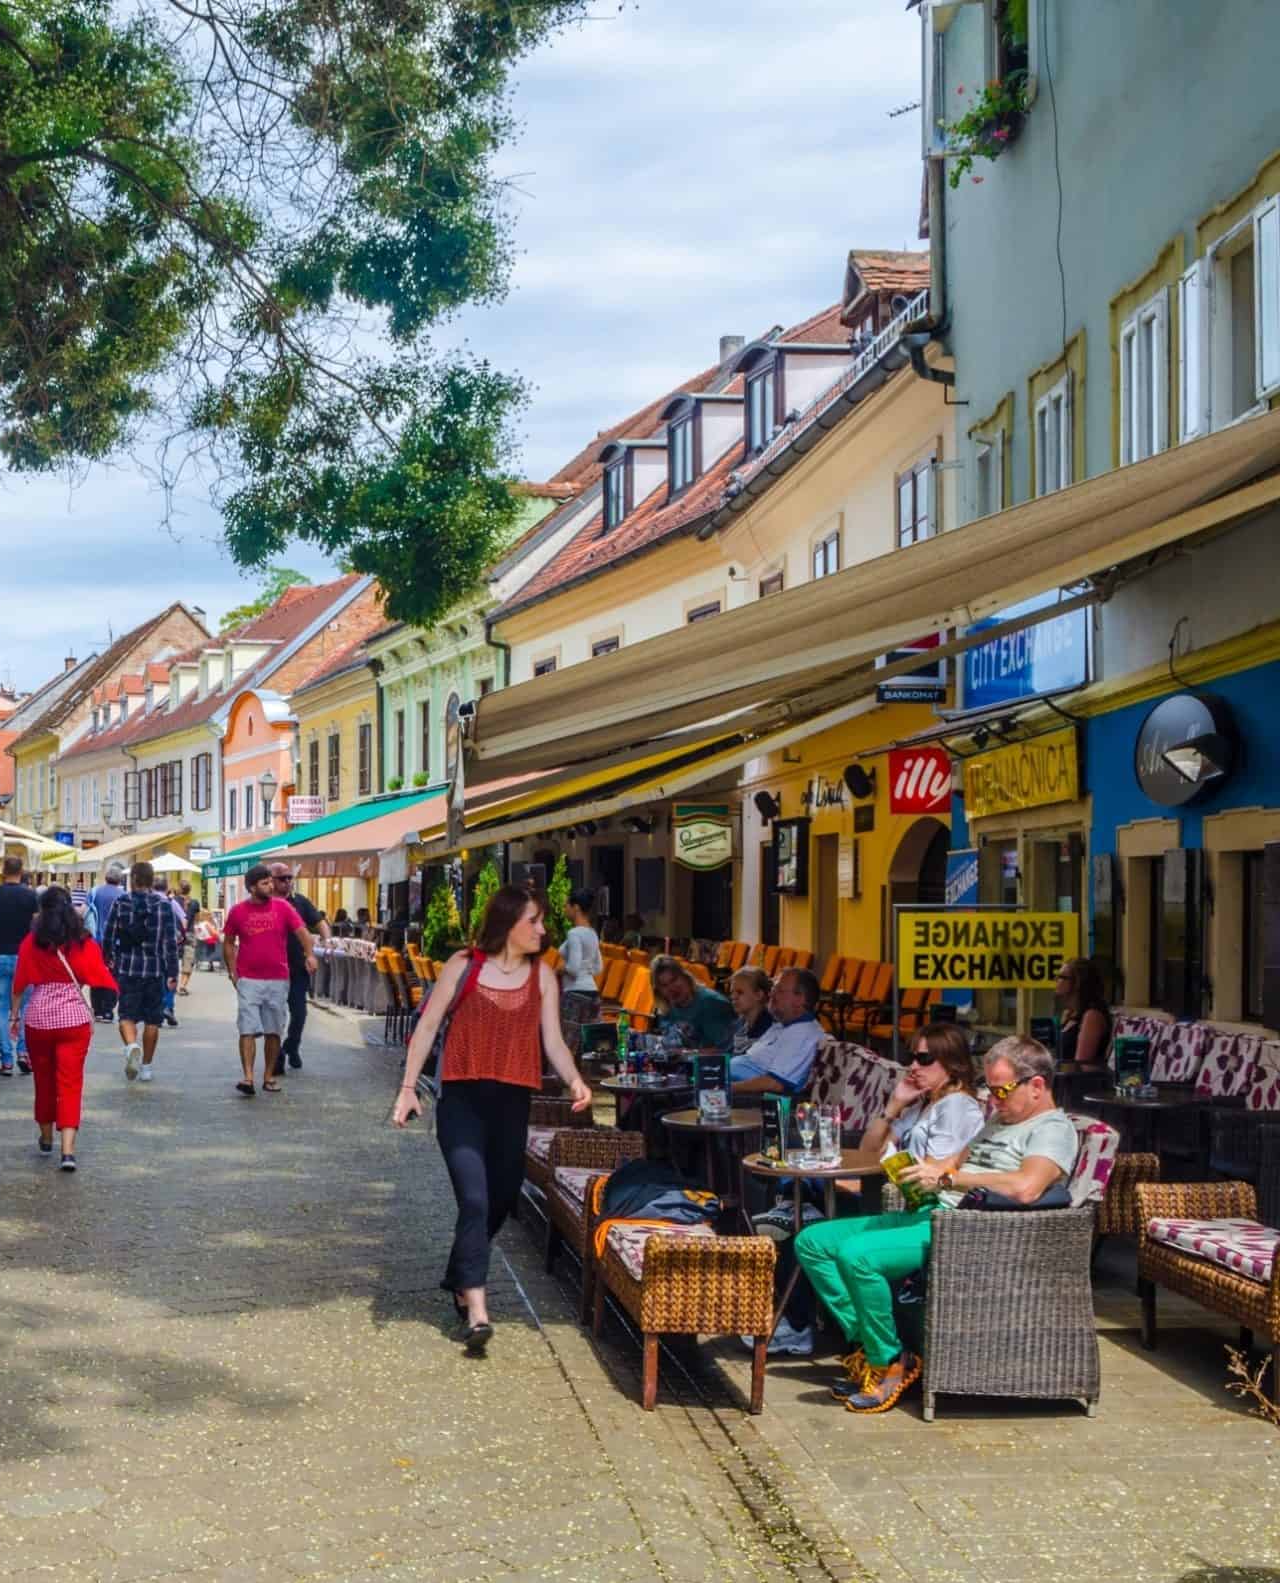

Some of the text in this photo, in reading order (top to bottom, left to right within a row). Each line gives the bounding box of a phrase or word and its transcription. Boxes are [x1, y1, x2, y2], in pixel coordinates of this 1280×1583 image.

[971, 639, 999, 690] CITY
[883, 690, 940, 700] BANKOMAT
[893, 757, 951, 808] illy
[914, 954, 1064, 981] EXCHANGE
